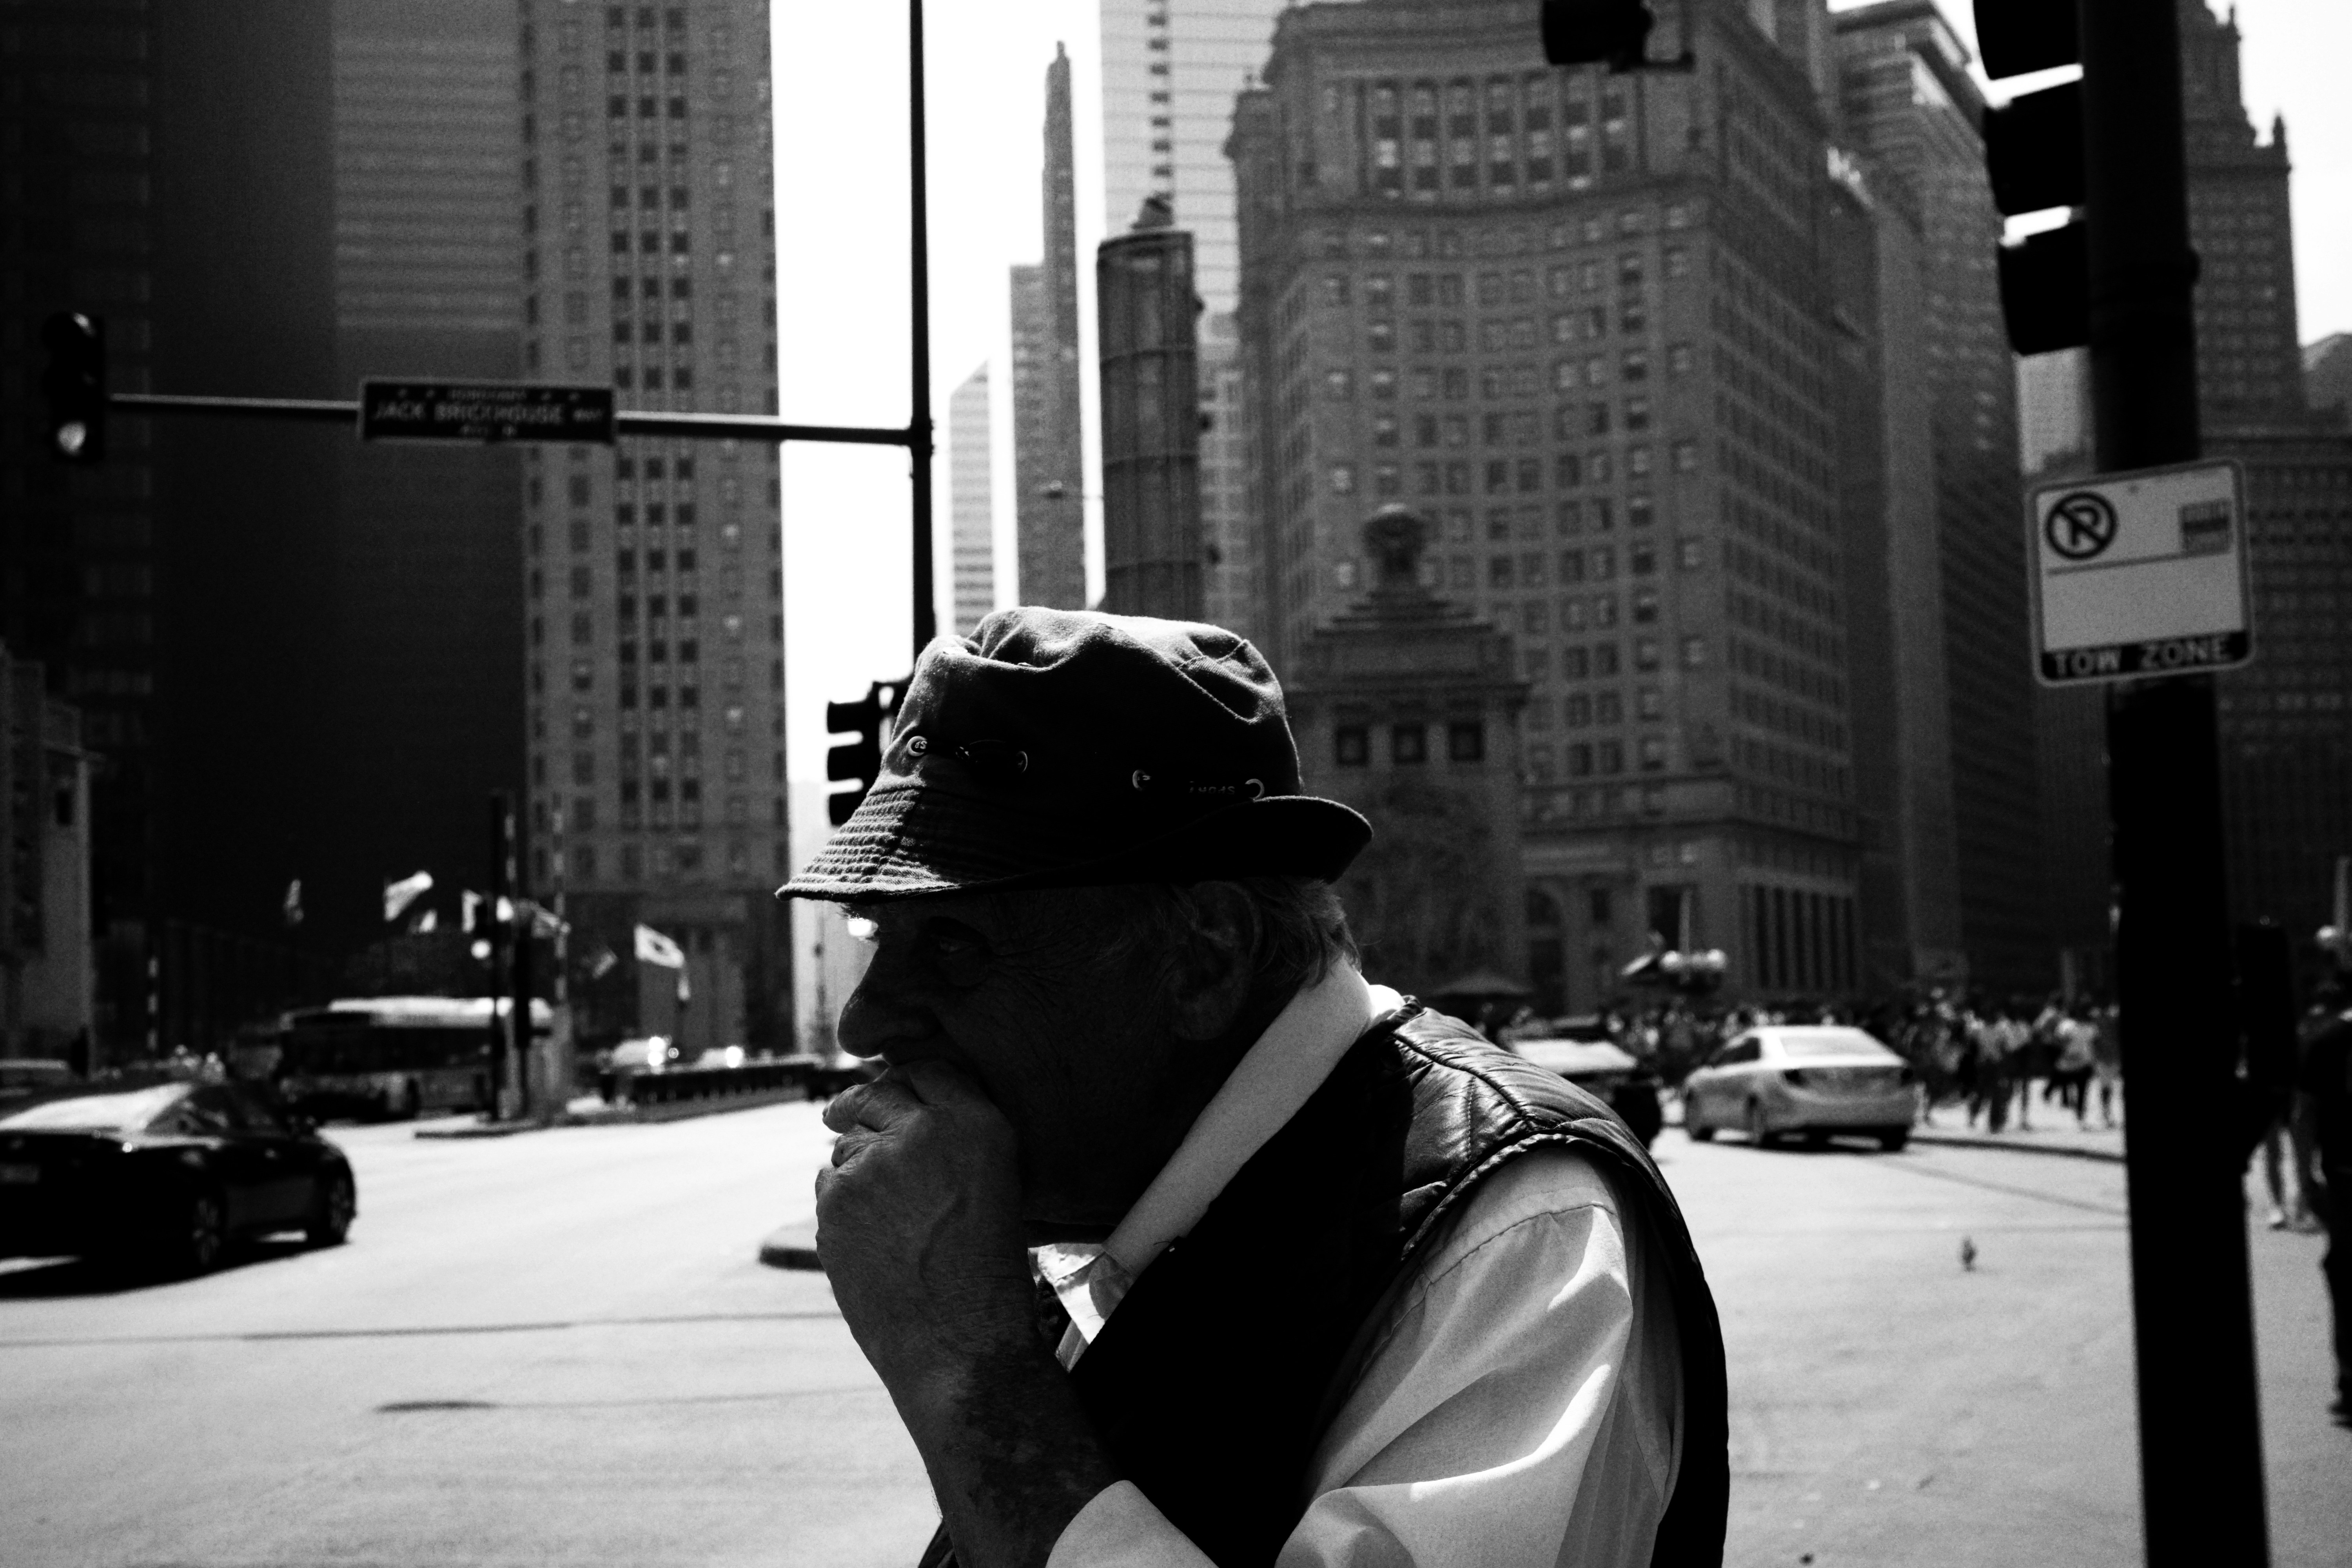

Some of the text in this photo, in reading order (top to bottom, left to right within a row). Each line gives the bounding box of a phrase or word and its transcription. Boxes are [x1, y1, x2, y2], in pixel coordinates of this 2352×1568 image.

[373, 400, 425, 420] JACK
[2053, 635, 2231, 676] TOW ZONE
